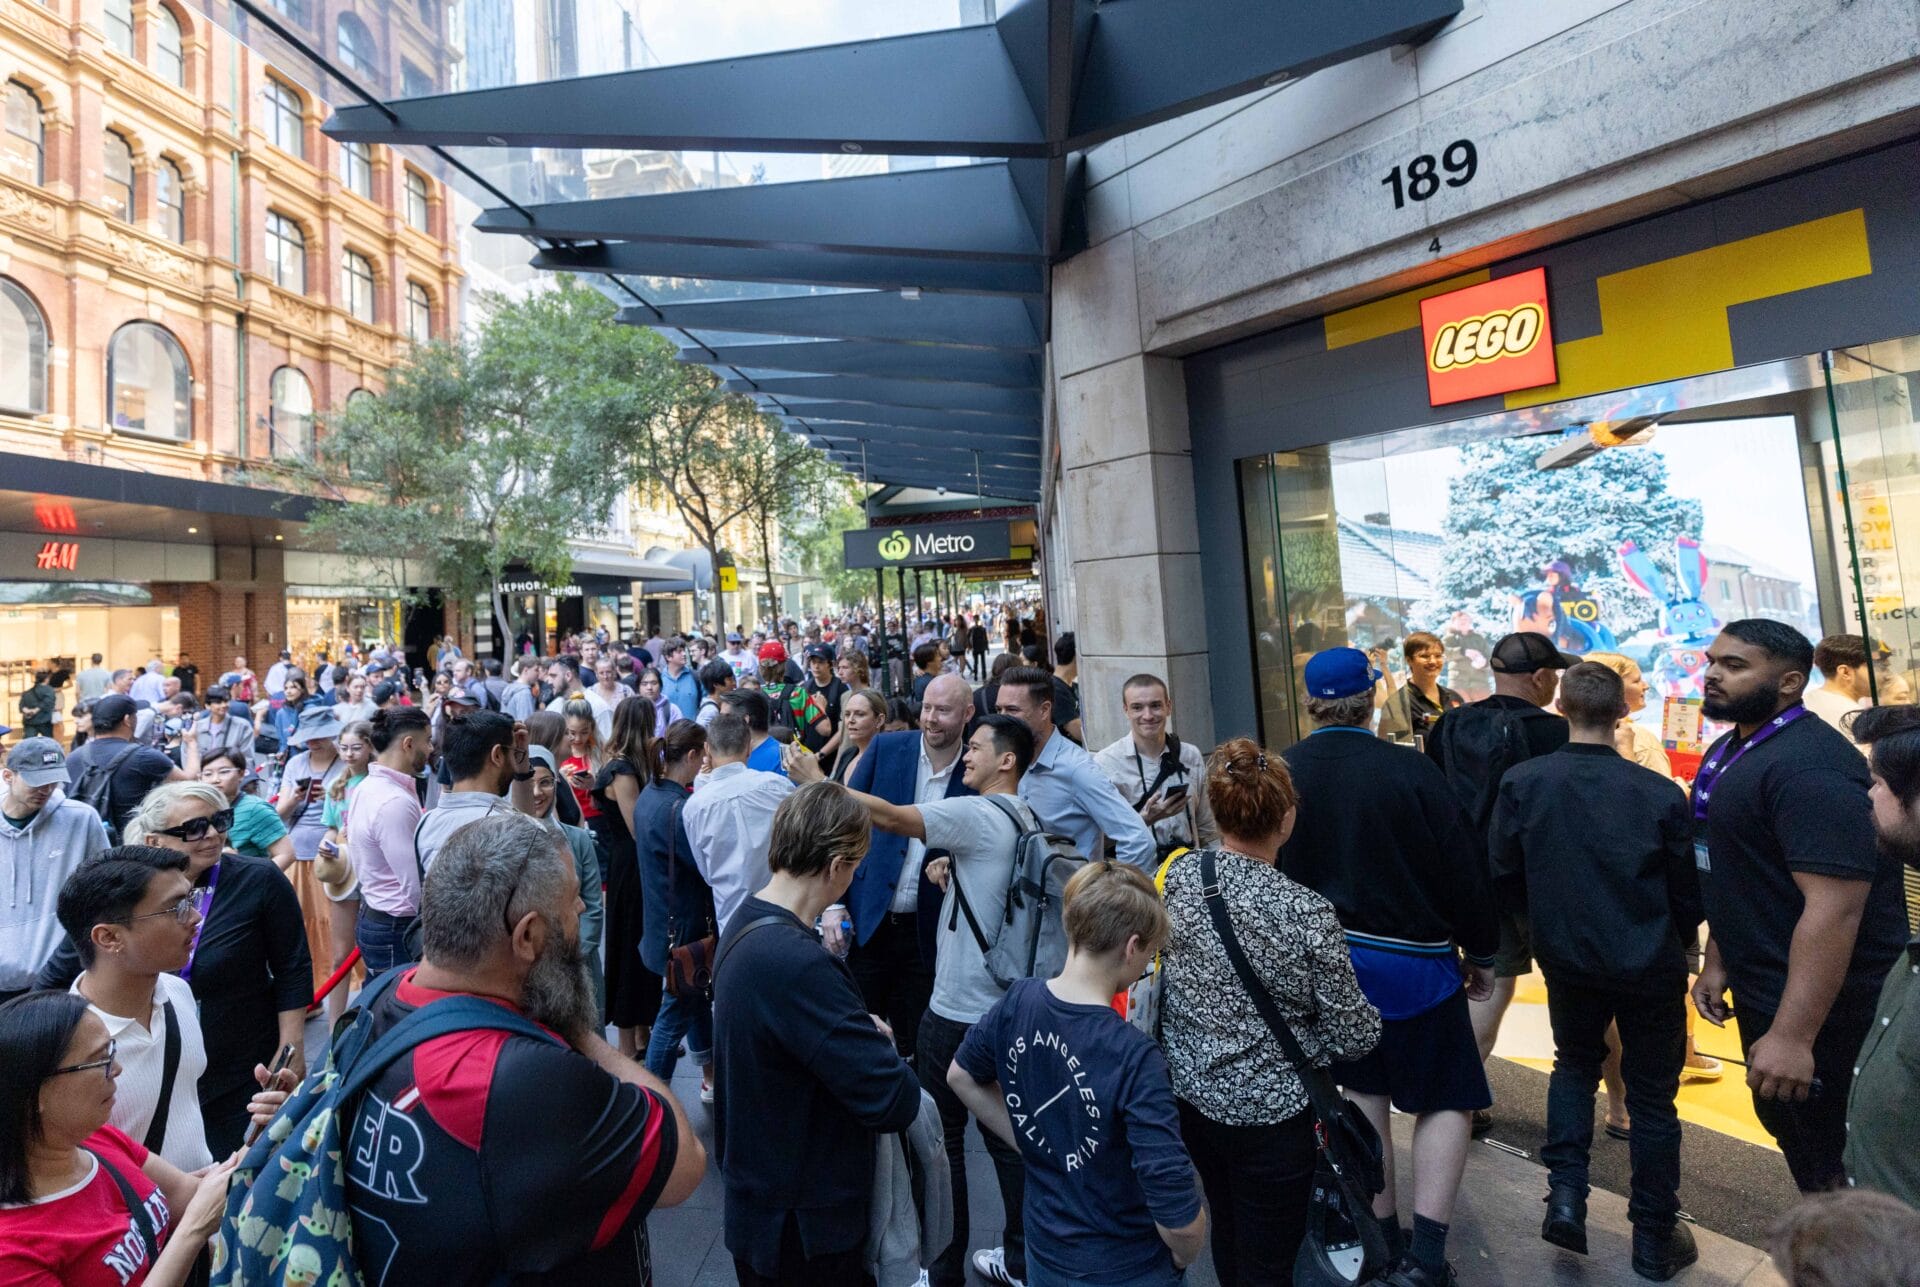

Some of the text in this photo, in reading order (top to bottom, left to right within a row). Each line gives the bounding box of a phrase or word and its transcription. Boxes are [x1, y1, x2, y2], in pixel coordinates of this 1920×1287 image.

[1381, 139, 1477, 210] 189
[1428, 236, 1442, 253] 4
[1431, 304, 1543, 372] LEGO
[37, 541, 79, 571] H&M
[915, 533, 975, 555] Metro
[498, 580, 548, 592] SEPHORA
[1006, 1029, 1101, 1119] LOS ANGELES
